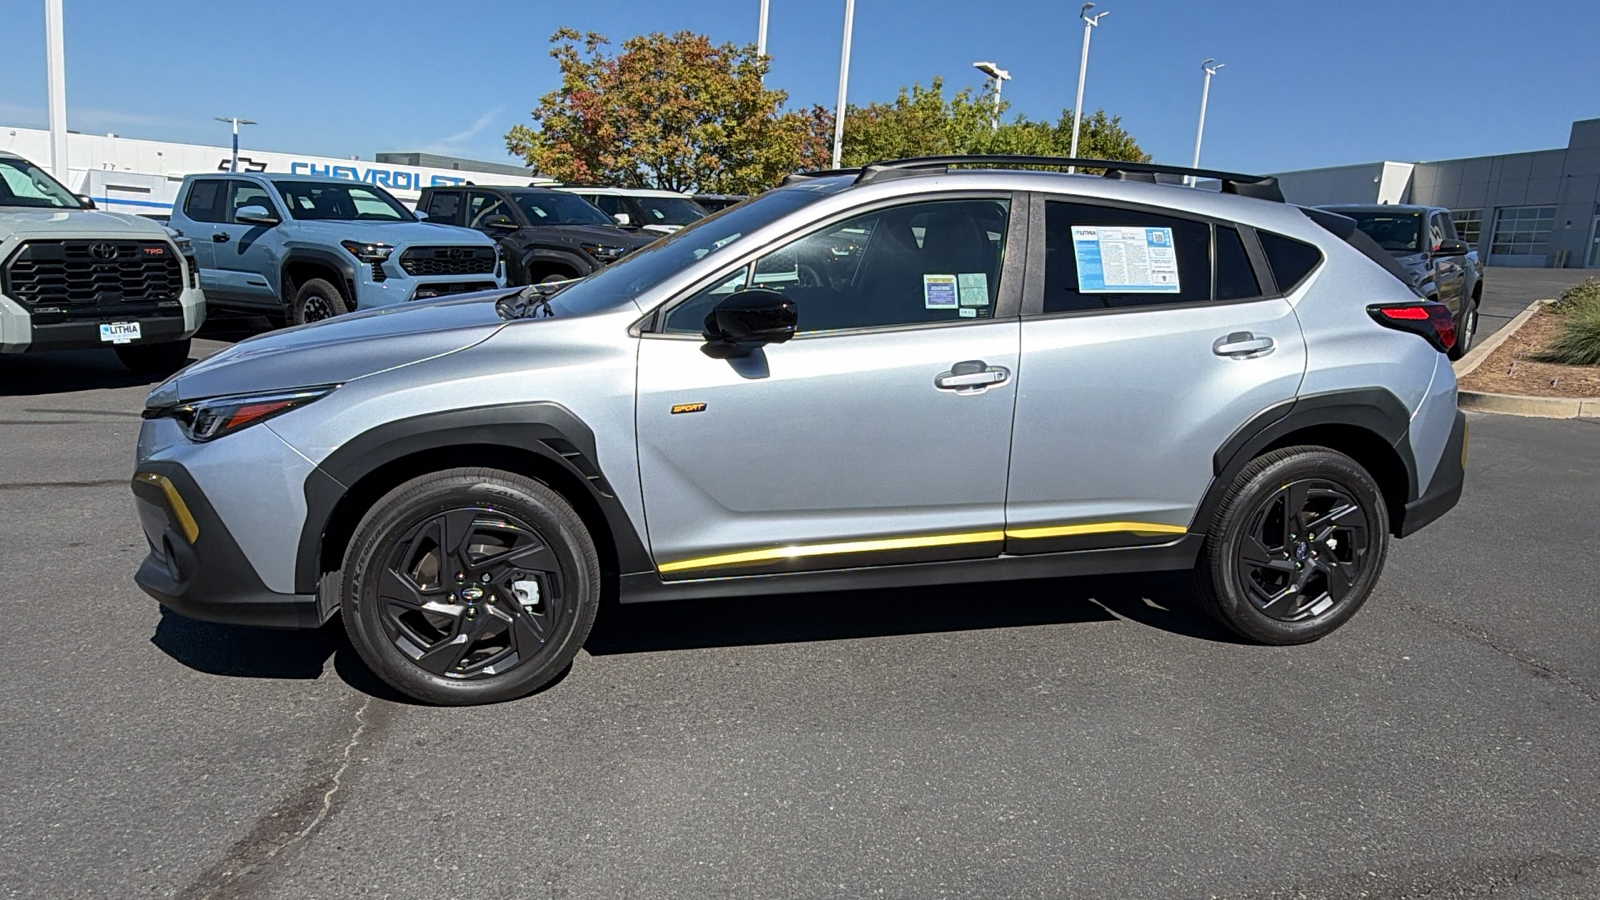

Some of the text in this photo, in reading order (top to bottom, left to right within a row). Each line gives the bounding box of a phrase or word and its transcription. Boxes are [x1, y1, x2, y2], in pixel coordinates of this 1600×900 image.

[291, 162, 466, 191] CHEVROLET
[109, 325, 138, 335] LITHIA
[673, 403, 705, 412] SPORT
